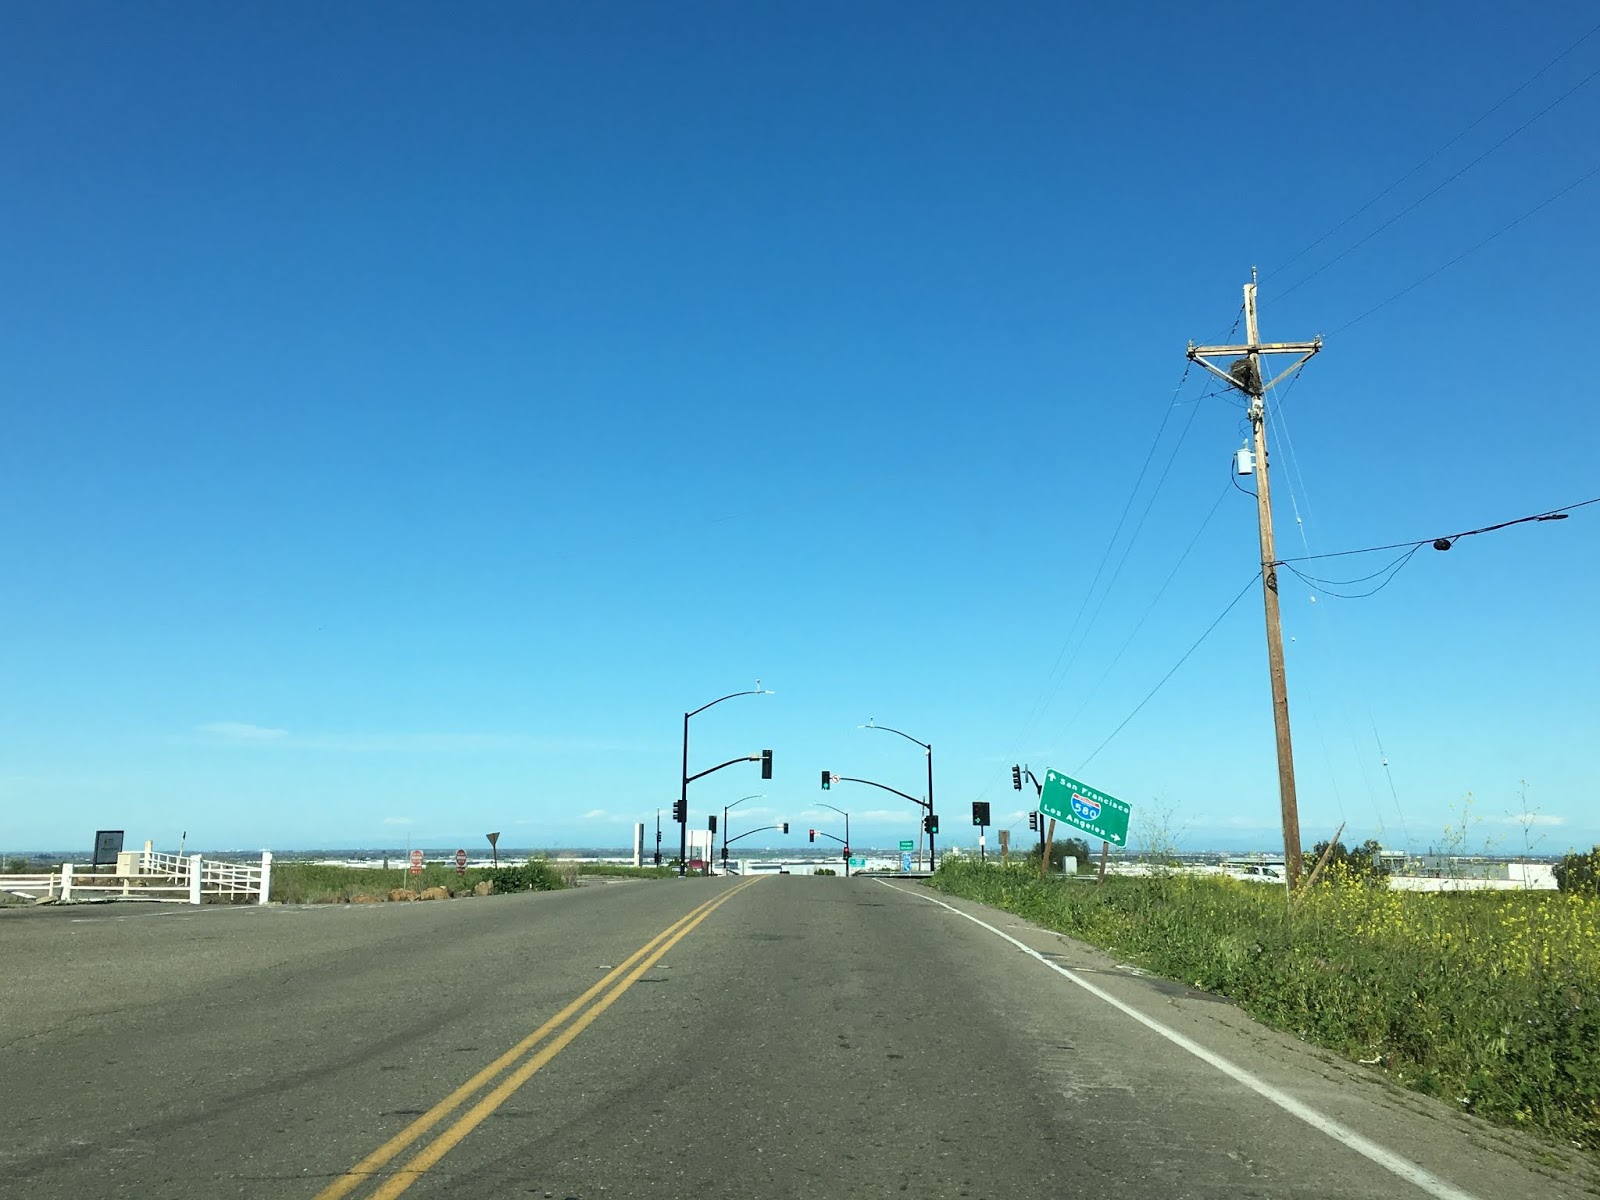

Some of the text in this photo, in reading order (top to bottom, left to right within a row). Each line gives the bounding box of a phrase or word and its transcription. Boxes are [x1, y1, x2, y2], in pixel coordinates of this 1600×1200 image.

[1059, 778, 1078, 791] San
[1081, 787, 1129, 814] Francisco
[1074, 803, 1097, 820] 580
[1043, 804, 1106, 836] Los Angeles
